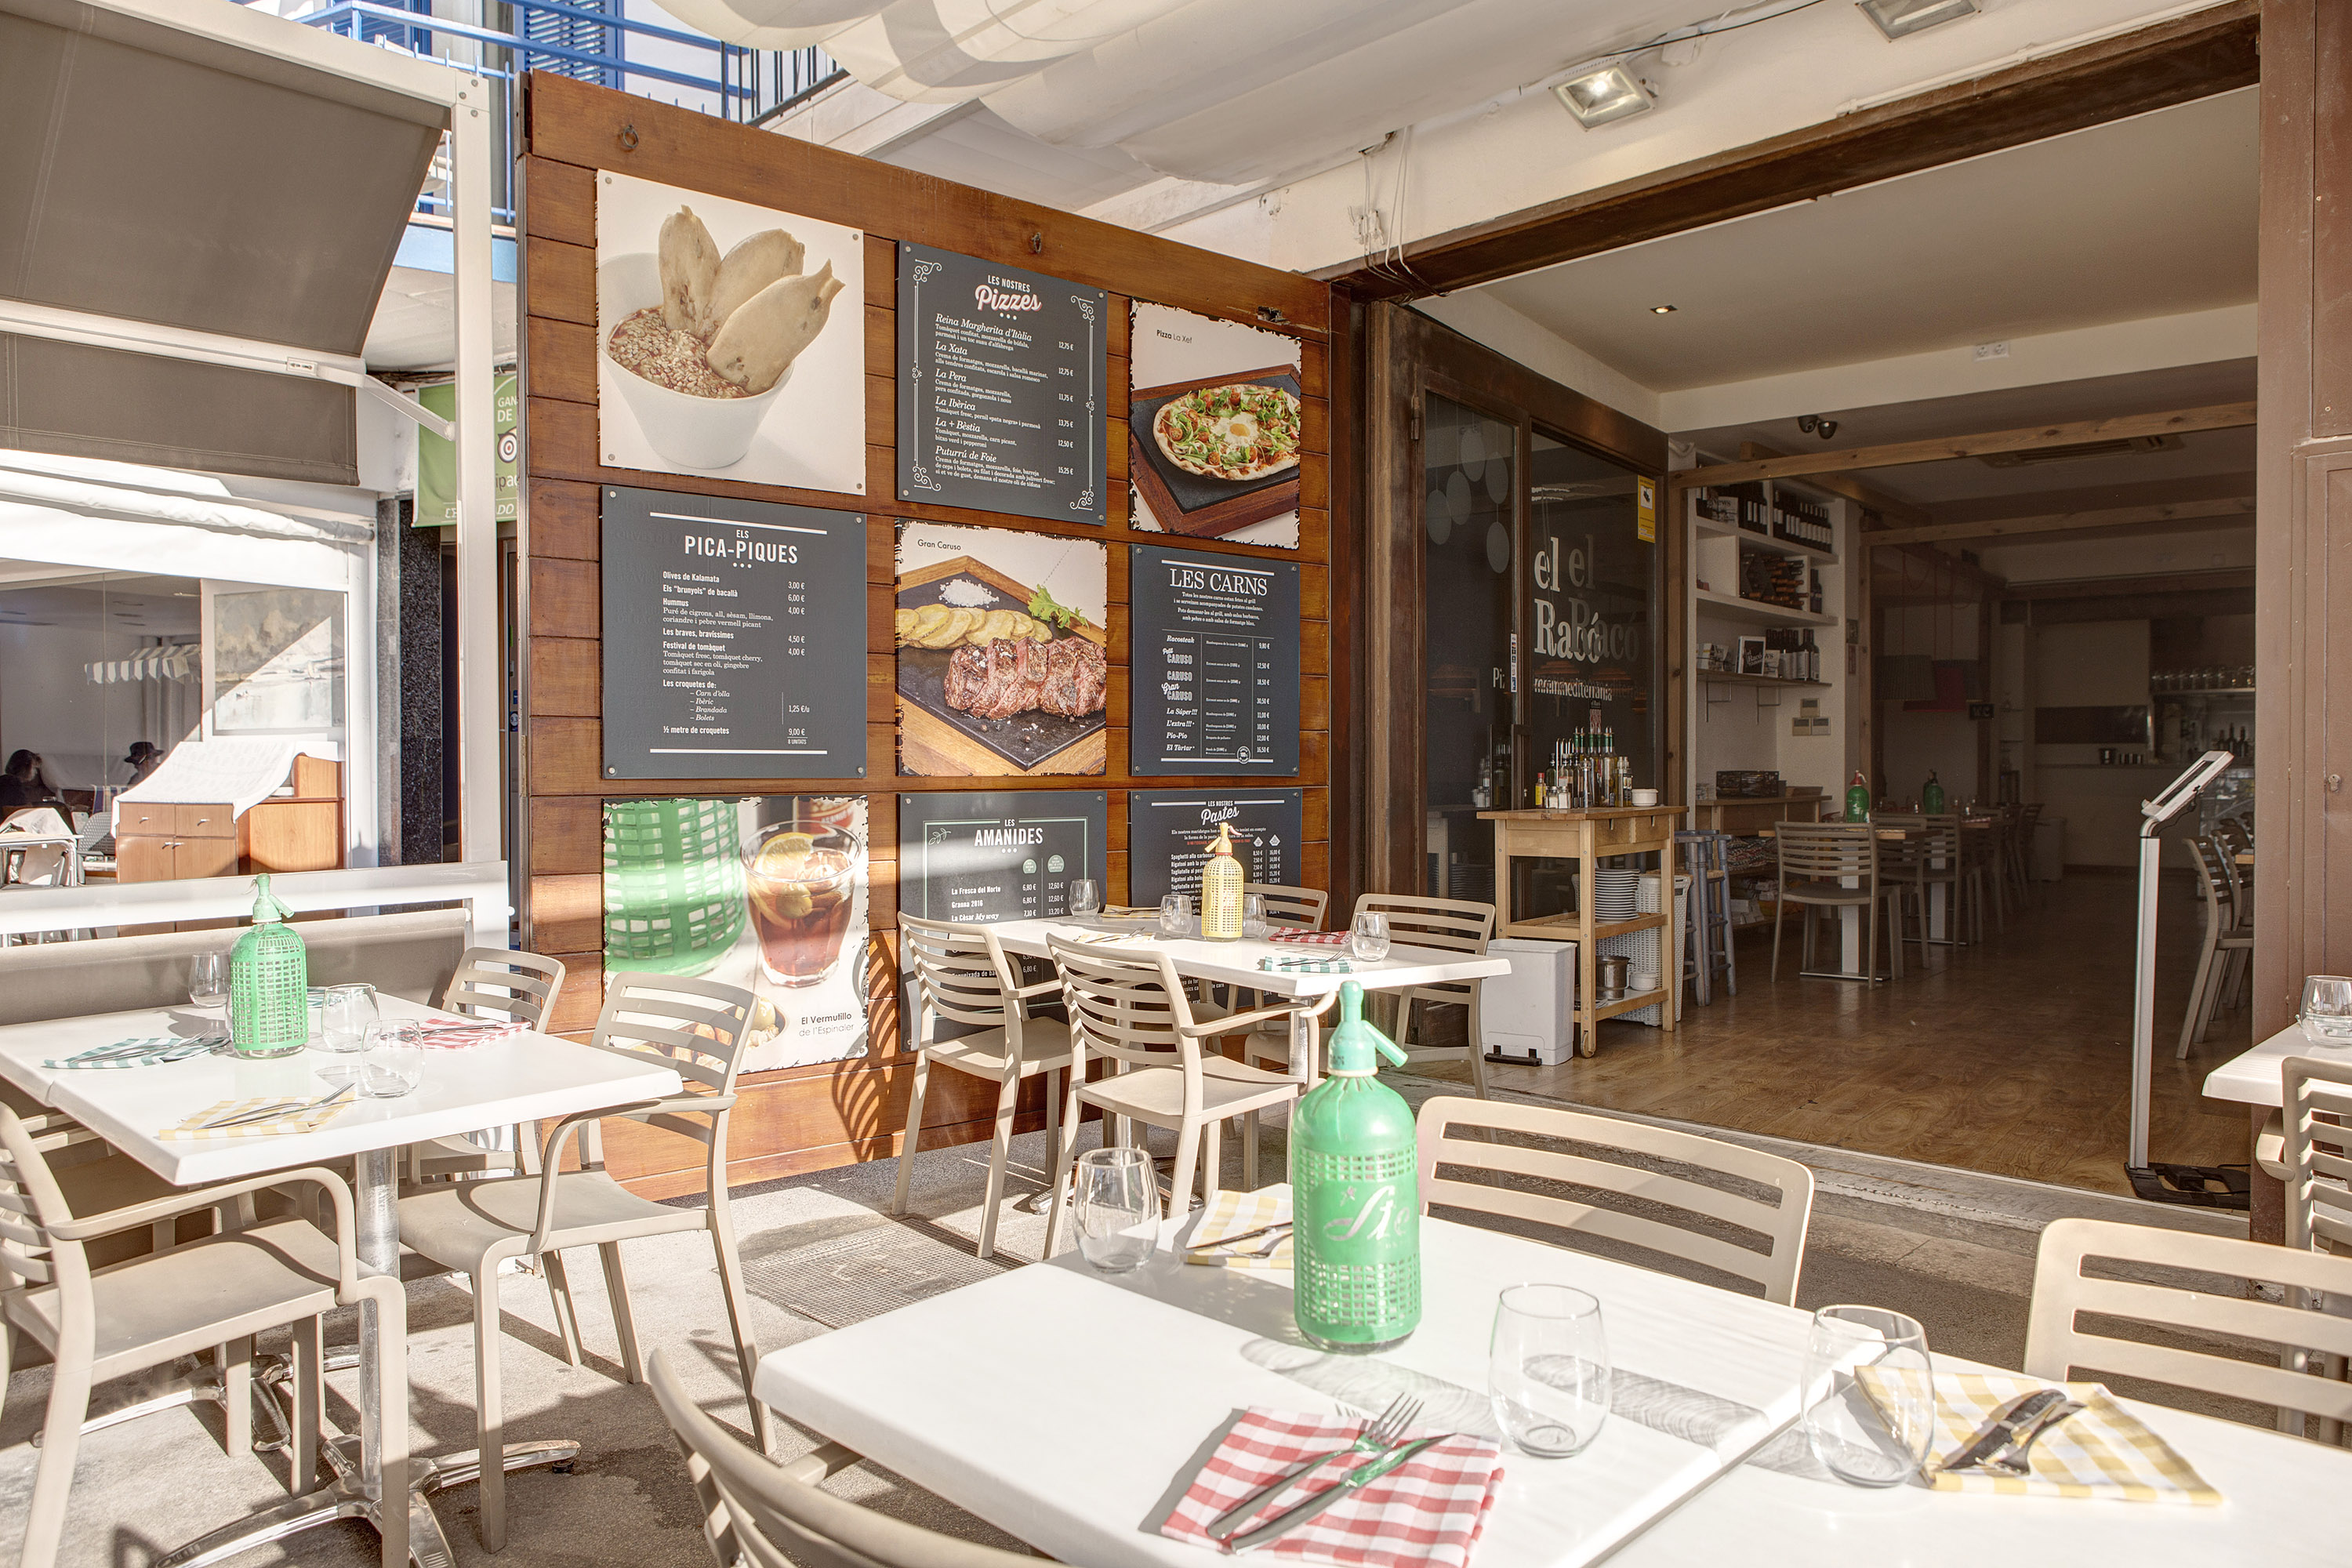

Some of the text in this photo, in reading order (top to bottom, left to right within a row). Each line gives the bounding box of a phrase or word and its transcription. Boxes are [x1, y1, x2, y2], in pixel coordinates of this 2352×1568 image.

[988, 274, 1030, 293] LES NOSTRES
[975, 285, 1041, 310] Pizzes
[935, 313, 959, 326] Reina
[960, 318, 1004, 336] Margherita
[1156, 329, 1172, 339] Pizza
[935, 340, 947, 351] La
[935, 368, 967, 382] La Pera
[935, 395, 975, 411] La Ibèrica
[497, 409, 513, 423] DE
[935, 417, 946, 426] La
[956, 420, 980, 433] Bèstia
[935, 445, 997, 463] Puturrú de Foie
[736, 529, 749, 539] ELS
[685, 535, 797, 564] PICA-PIQUES
[917, 539, 961, 550] Gran Caruso
[1534, 536, 1560, 592] el
[663, 571, 681, 580] Olives
[691, 573, 720, 583] Kalamata
[1170, 568, 1267, 596] LES CARNS
[663, 584, 673, 593] Els
[717, 588, 738, 597] bacallà
[663, 597, 689, 607] Hummus
[663, 607, 679, 615] Puré
[689, 609, 713, 618] cigrons,
[663, 627, 734, 639] Les braves, bravíssimes
[1534, 598, 1601, 663] Racó
[663, 641, 687, 651] Festival
[697, 643, 725, 652] tomàquet
[663, 650, 763, 663] Tomàquet fresc, tomàquet cherry,
[1167, 653, 1192, 665] CARUSO
[1167, 670, 1192, 681] CARUSO
[675, 681, 706, 689] croquetes
[1161, 682, 1180, 695] Gran
[1167, 690, 1192, 701] CARUSO
[1201, 806, 1240, 826] Pastes
[975, 827, 1043, 847] AMANIDES
[810, 1012, 851, 1024] Vermutillo
